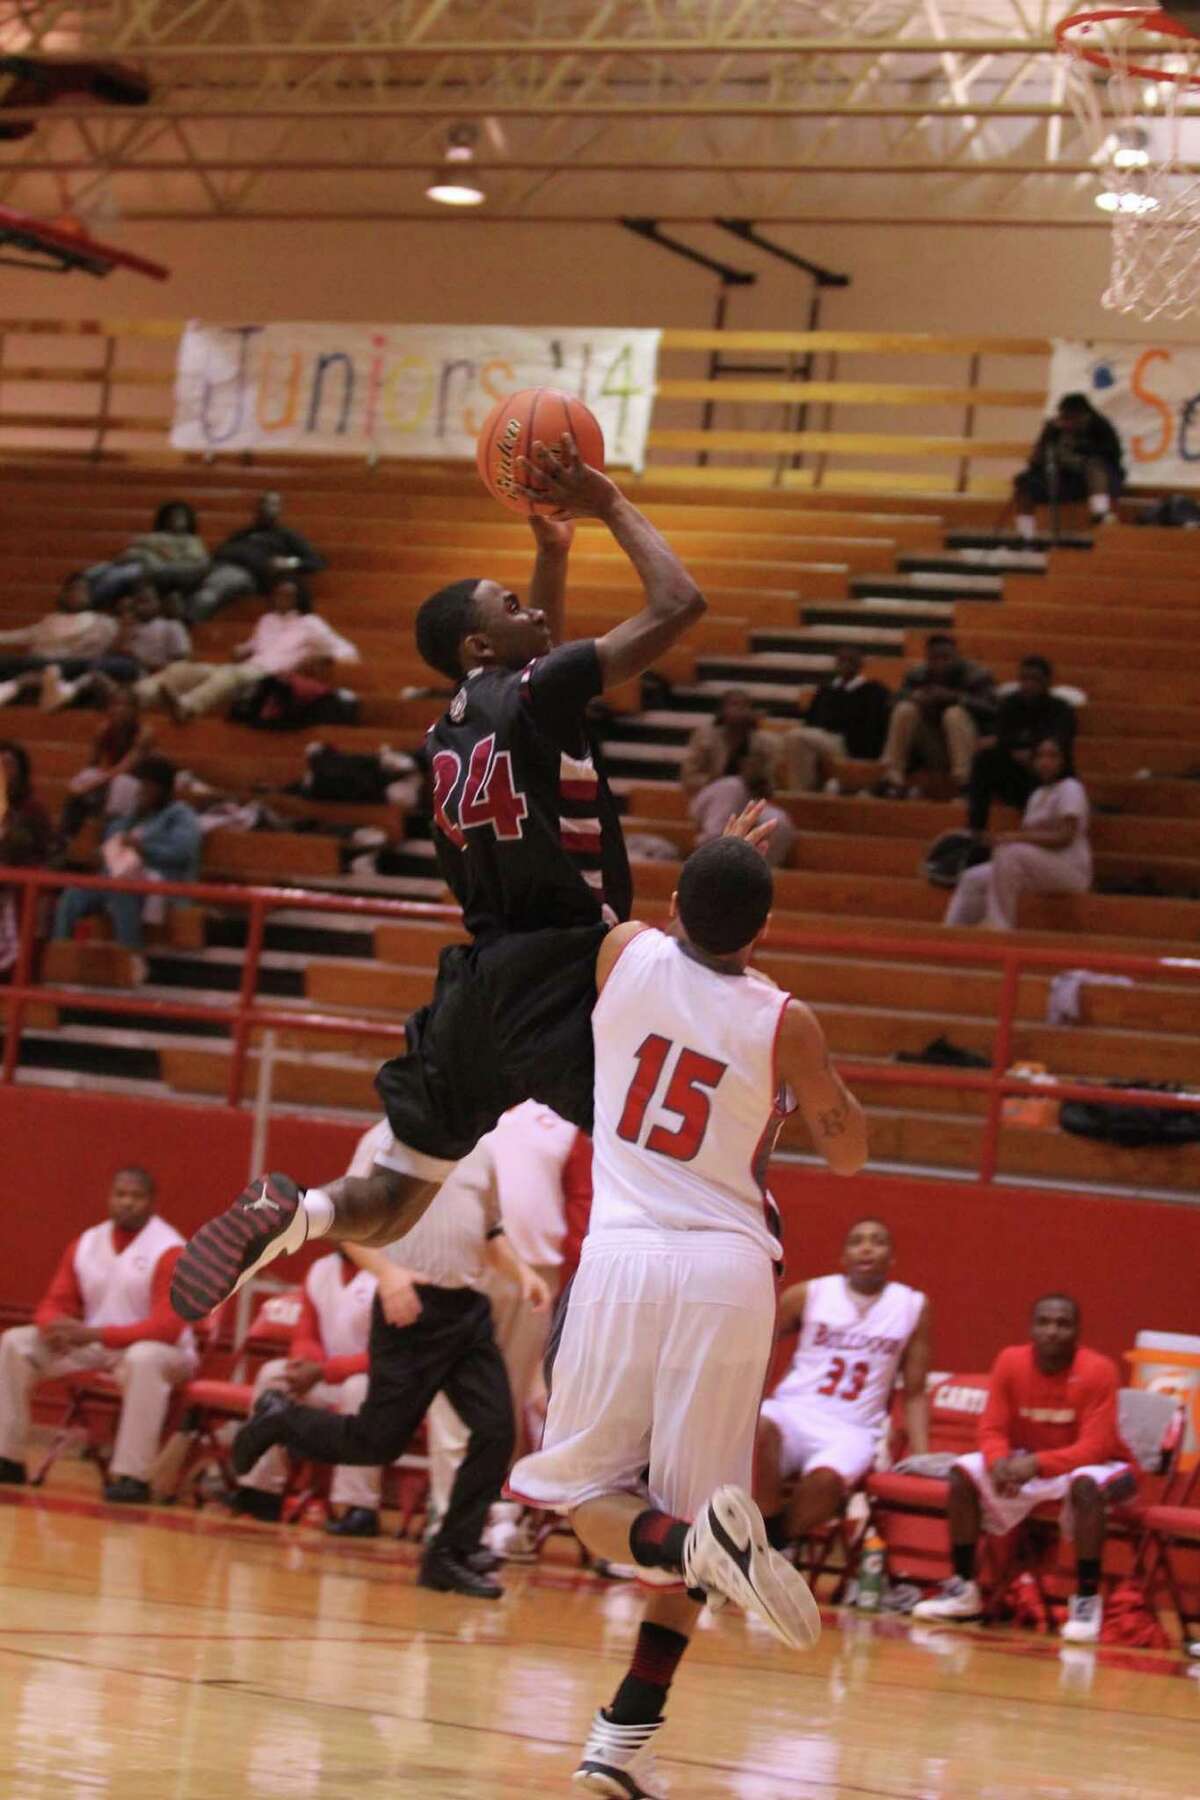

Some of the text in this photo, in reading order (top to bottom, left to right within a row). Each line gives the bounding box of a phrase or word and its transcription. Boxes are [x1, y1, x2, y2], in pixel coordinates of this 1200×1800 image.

[201, 324, 516, 444] Juniors
[432, 732, 528, 851] 24
[616, 1033, 728, 1161] 15
[817, 1356, 869, 1402] 33
